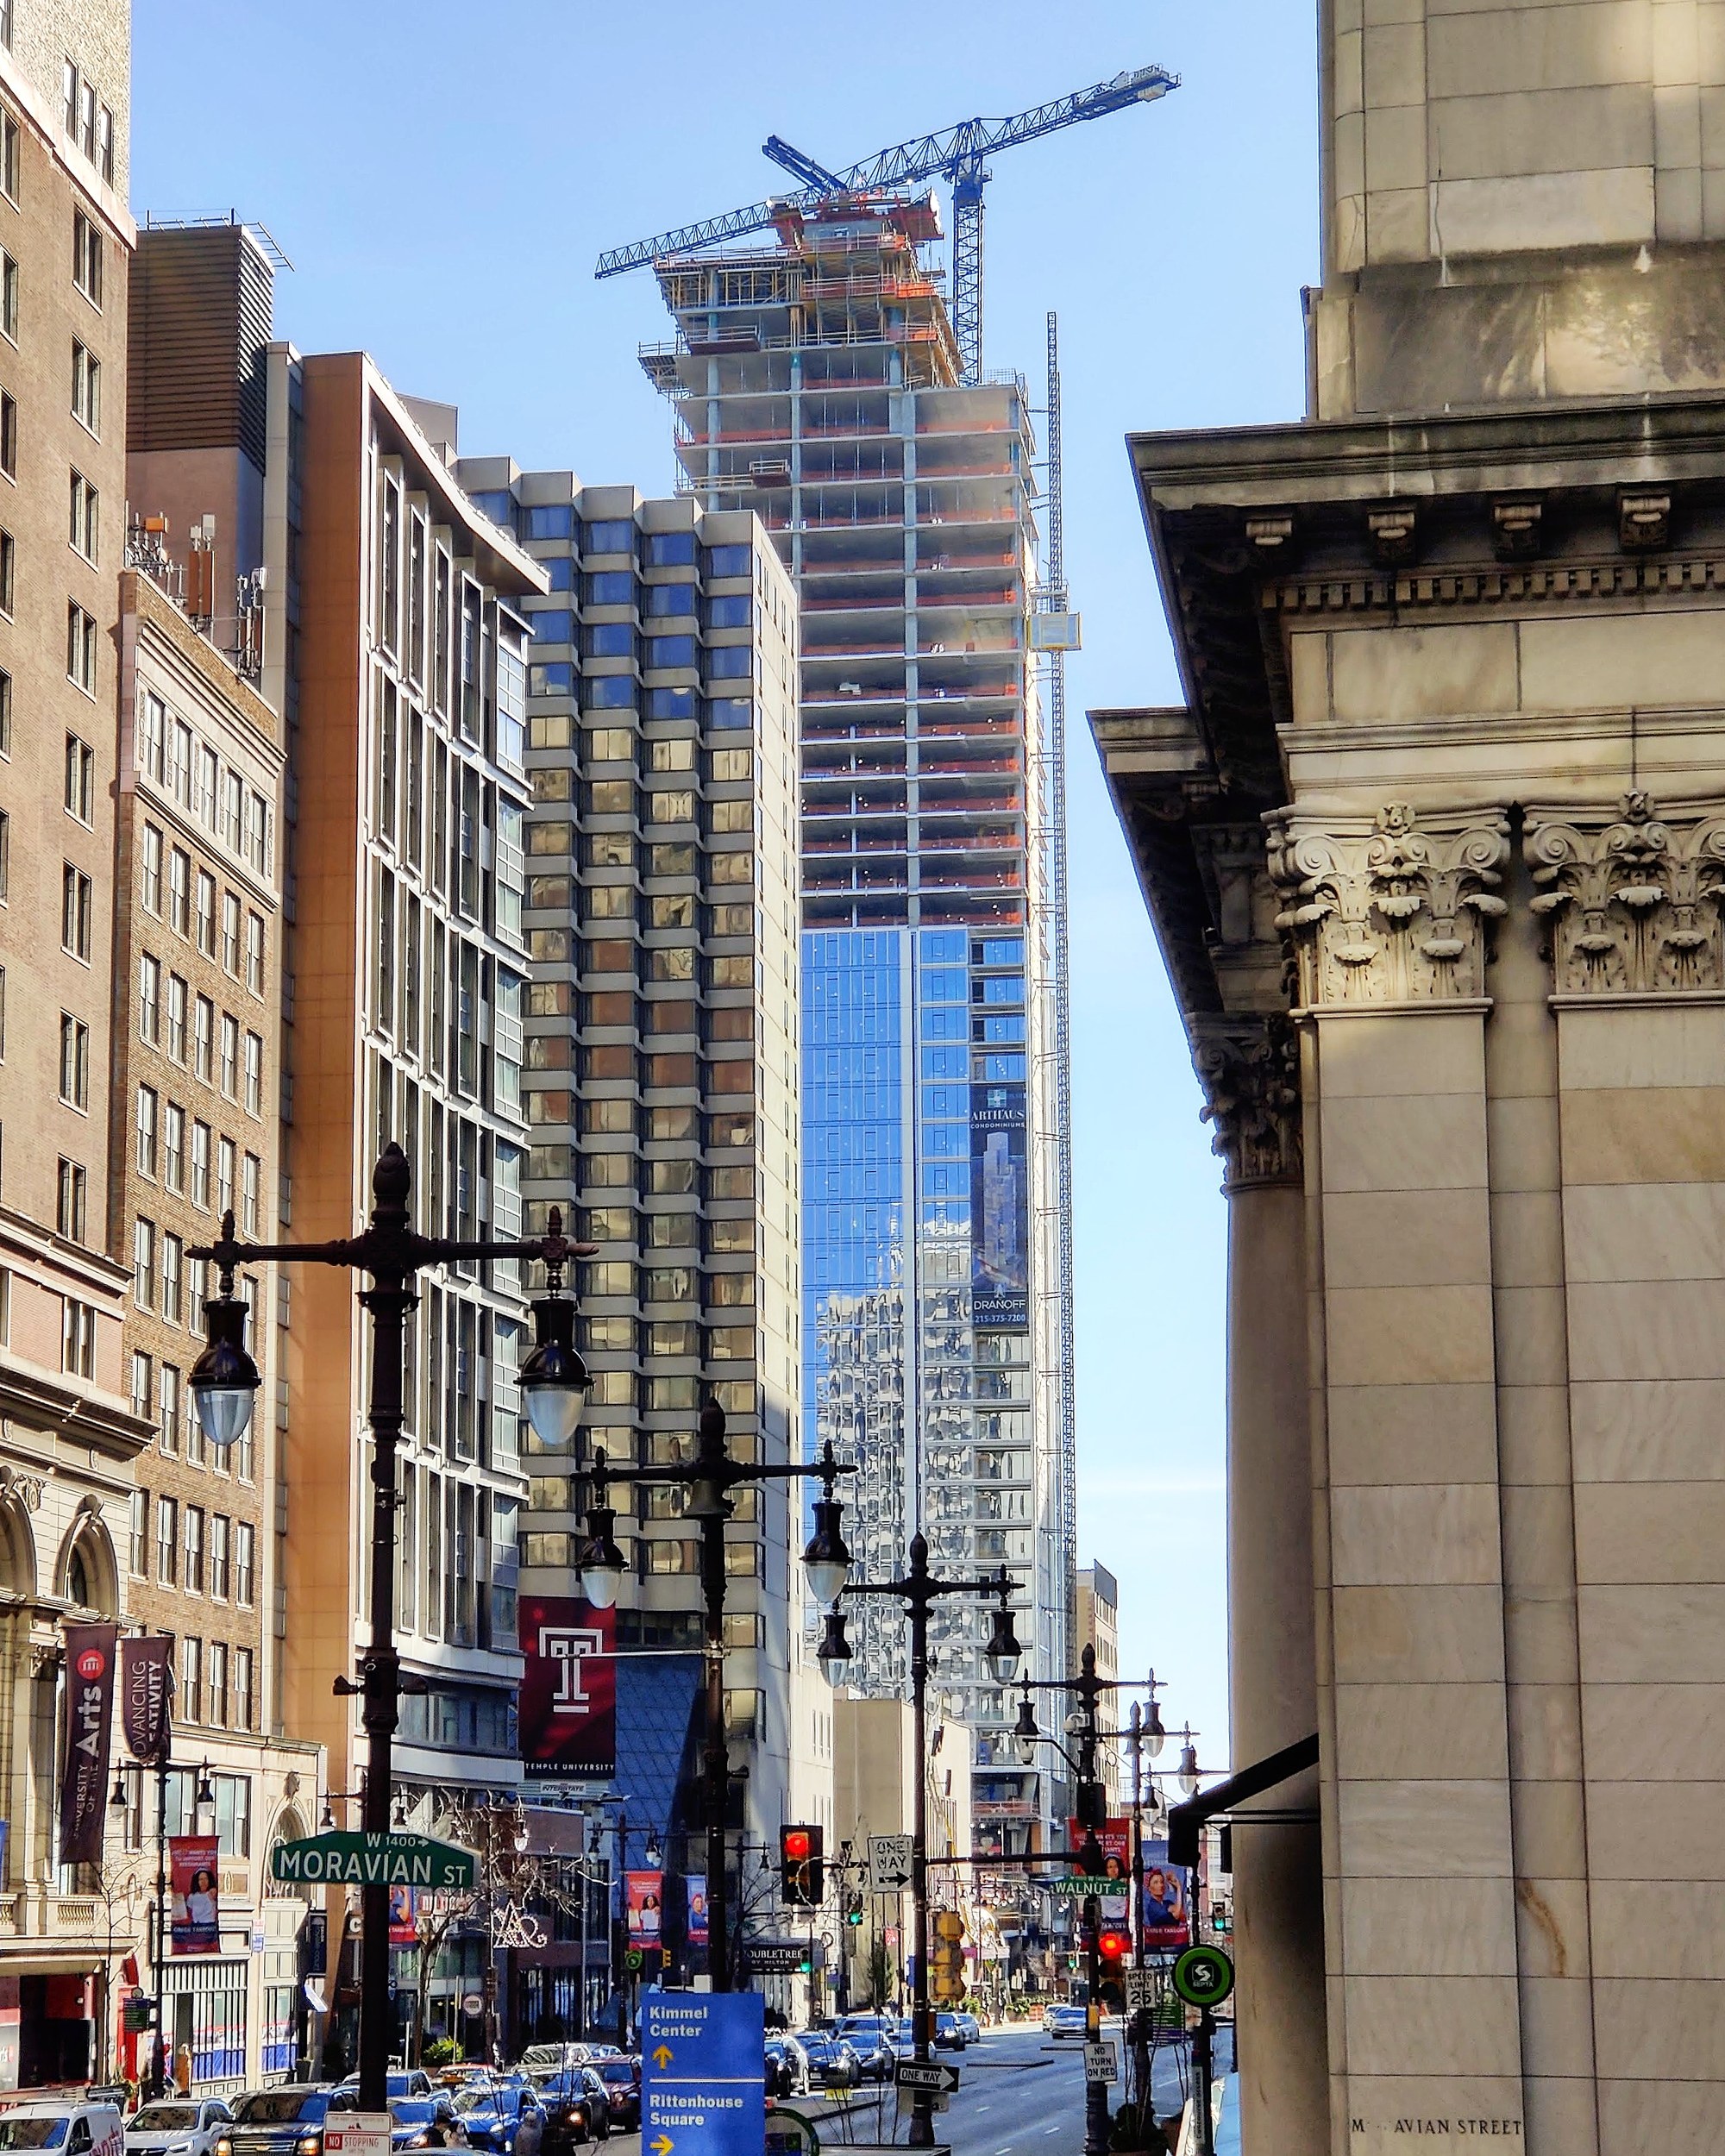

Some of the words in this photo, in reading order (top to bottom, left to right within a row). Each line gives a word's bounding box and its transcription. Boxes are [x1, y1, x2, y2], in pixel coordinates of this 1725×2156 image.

[974, 1300, 1026, 1310] DRANOFF
[975, 1314, 1026, 1323] 215-375-7200
[132, 1661, 147, 1756] DVANCING
[76, 1685, 102, 1757] Arts
[367, 1833, 380, 1847] W
[386, 1837, 416, 1846] 1400
[877, 1841, 905, 1854] ONE
[280, 1851, 430, 1883] MORAVIAN
[444, 1866, 467, 1884] ST
[877, 1856, 906, 1869] WAY
[1056, 1882, 1111, 1895] WALNUT
[1131, 1990, 1151, 2004] 25
[649, 2007, 707, 2020] Kimmel
[649, 2024, 702, 2037] Center
[1095, 2046, 1105, 2055] NO
[902, 2069, 919, 2080] ONE
[924, 2071, 940, 2083] WAY
[1088, 2068, 1098, 2077] ON
[1101, 2067, 1114, 2078] RED
[649, 2095, 743, 2108] Rittenhouse
[650, 2112, 704, 2127] Square
[1352, 2119, 1449, 2134] MAVIAN
[1458, 2120, 1521, 2134] STREET
[329, 2136, 340, 2147] NO
[345, 2137, 380, 2147] STOPPING
